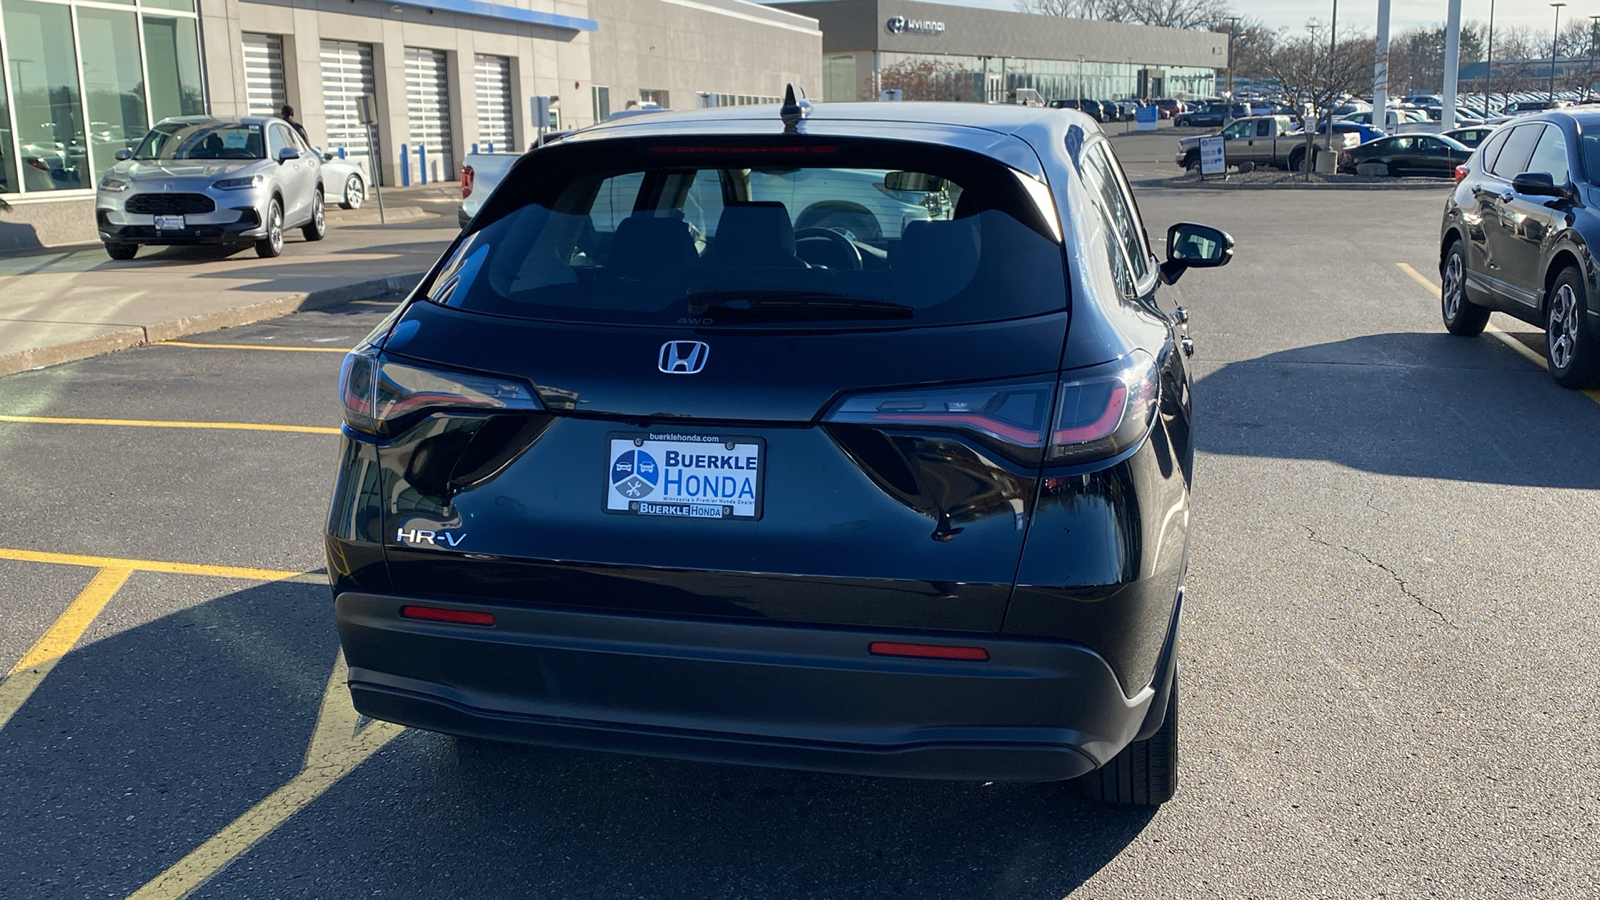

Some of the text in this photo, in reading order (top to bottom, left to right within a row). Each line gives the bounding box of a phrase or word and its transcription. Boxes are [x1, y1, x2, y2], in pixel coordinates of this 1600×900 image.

[676, 317, 714, 325] AWD
[649, 432, 719, 443] buerklehonda.com
[665, 450, 757, 470] BUERKLE
[663, 469, 755, 499] HONDA
[396, 527, 467, 546] HR-V
